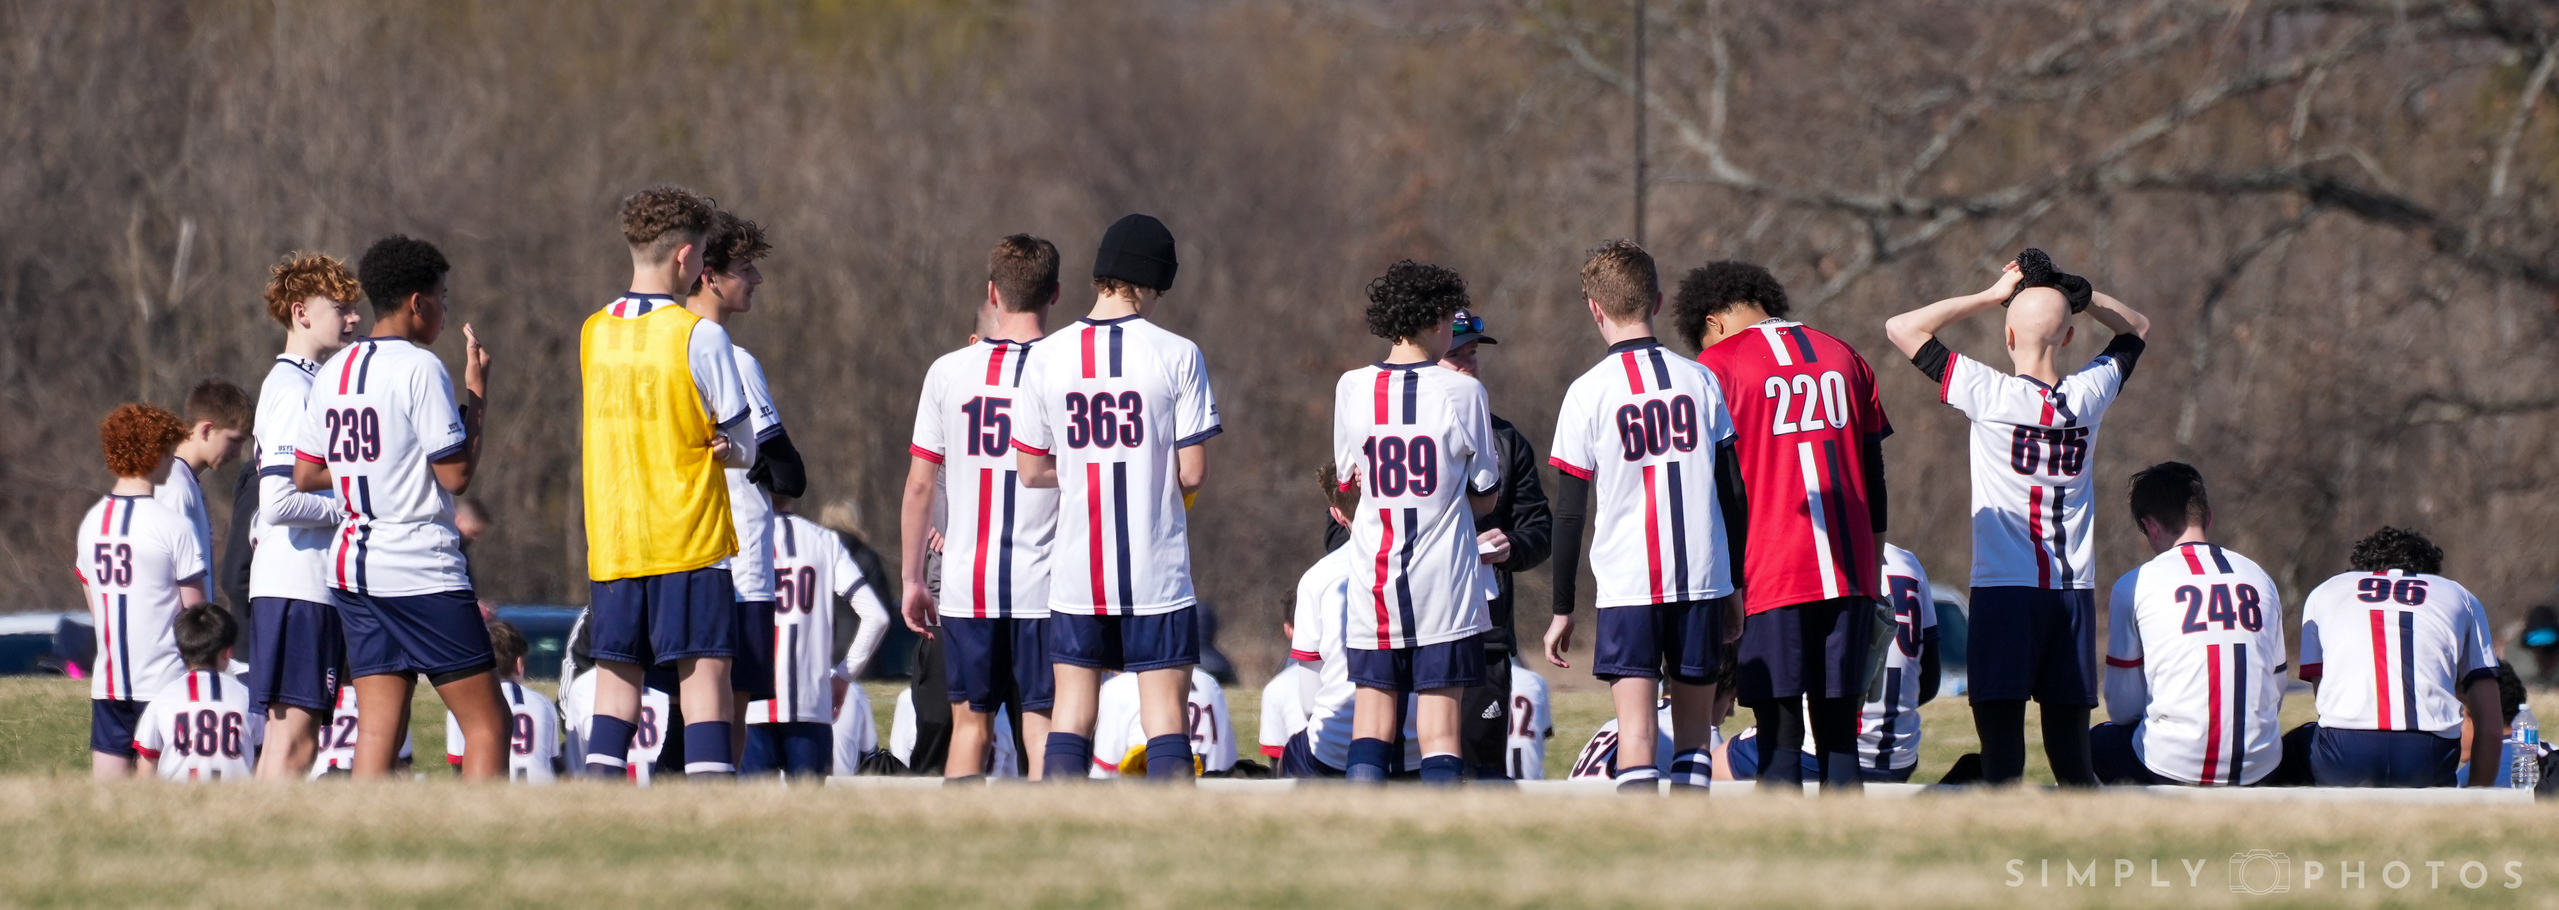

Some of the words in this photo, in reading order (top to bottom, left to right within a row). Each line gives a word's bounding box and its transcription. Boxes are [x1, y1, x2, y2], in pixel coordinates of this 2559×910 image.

[961, 396, 1012, 457] 15
[1066, 391, 1144, 449] 363
[1616, 394, 1698, 461] 609
[1765, 370, 1848, 436] 220
[325, 407, 381, 463] 239
[2010, 424, 2090, 477] 616
[1362, 435, 1438, 498] 189
[94, 543, 133, 588] 53
[775, 566, 816, 614] 50
[1886, 575, 1922, 658] 5
[2174, 583, 2263, 635] 248
[2357, 577, 2429, 606] 96
[173, 709, 244, 758] 486
[512, 713, 534, 755] 9
[631, 706, 658, 748] 8
[1188, 701, 1218, 744] 21
[1509, 696, 1535, 738] 2
[1572, 731, 1618, 778] 52
